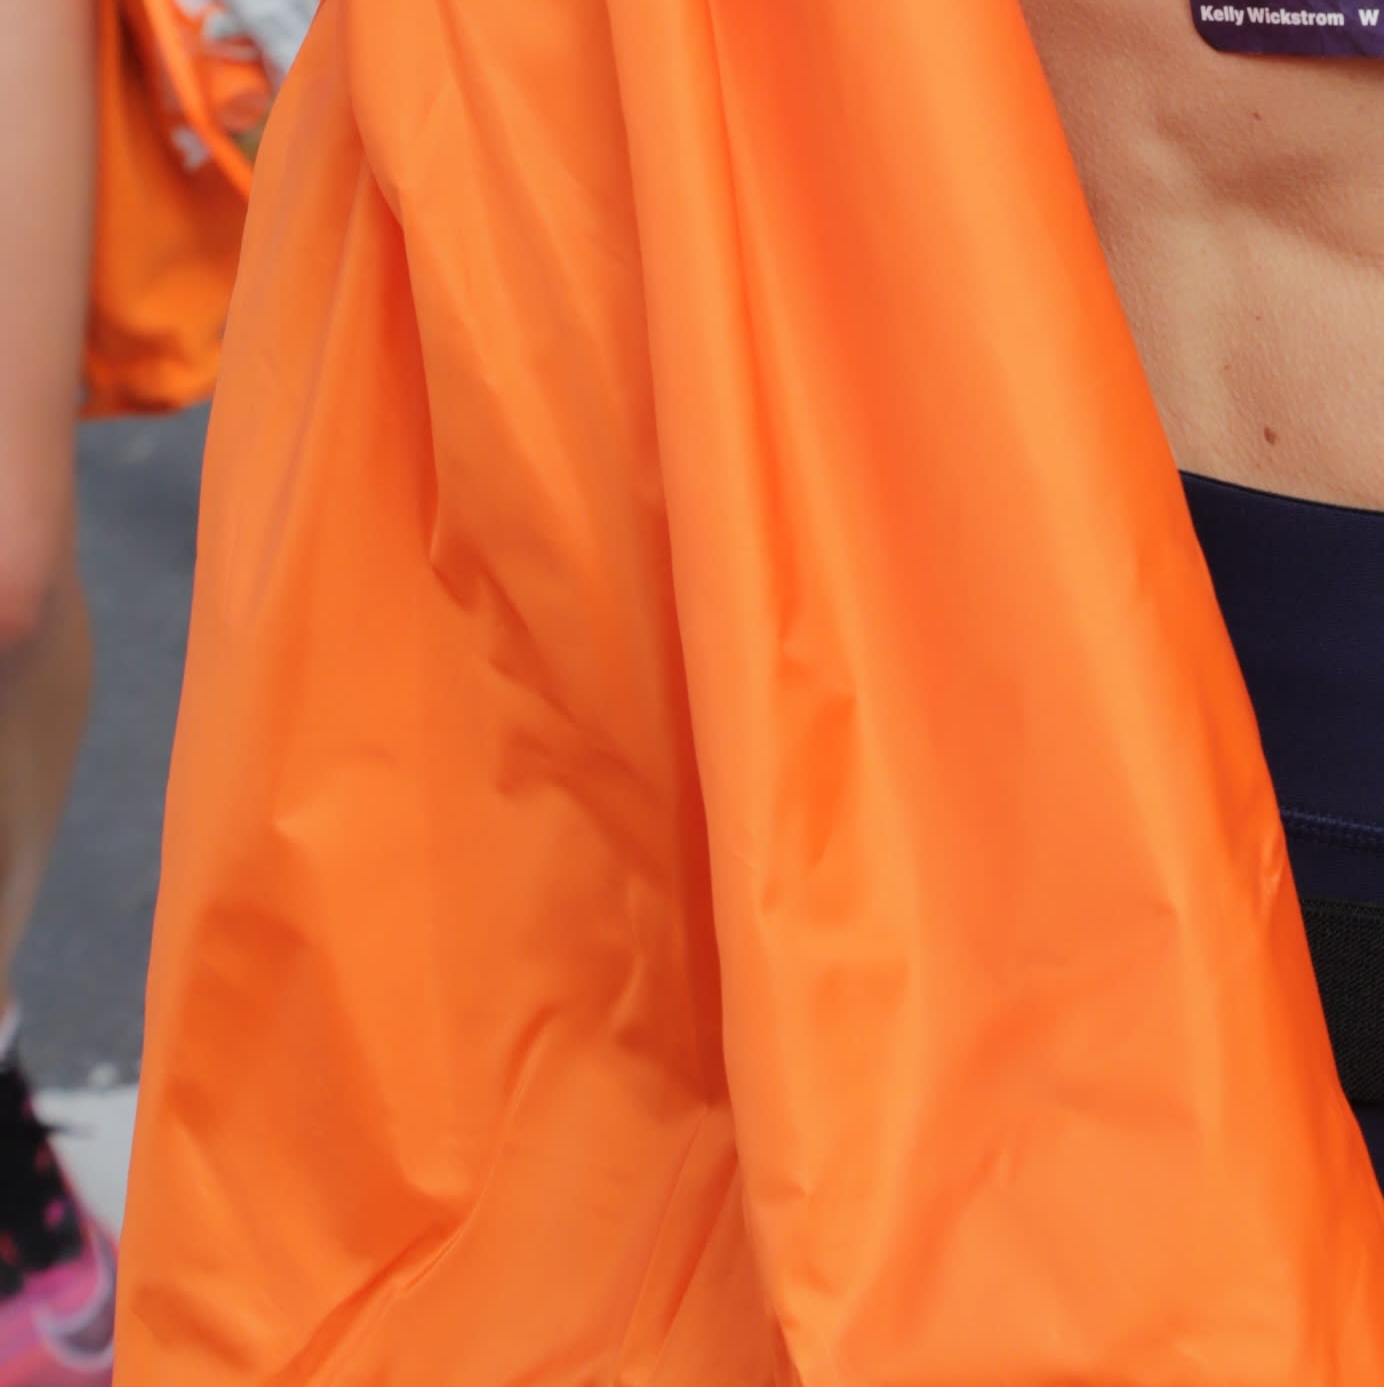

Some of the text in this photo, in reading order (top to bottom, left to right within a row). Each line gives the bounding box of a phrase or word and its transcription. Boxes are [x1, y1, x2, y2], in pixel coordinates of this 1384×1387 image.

[1200, 5, 1244, 26] Kelly
[1247, 7, 1345, 27] Wickstrom
[1358, 9, 1380, 27] W
